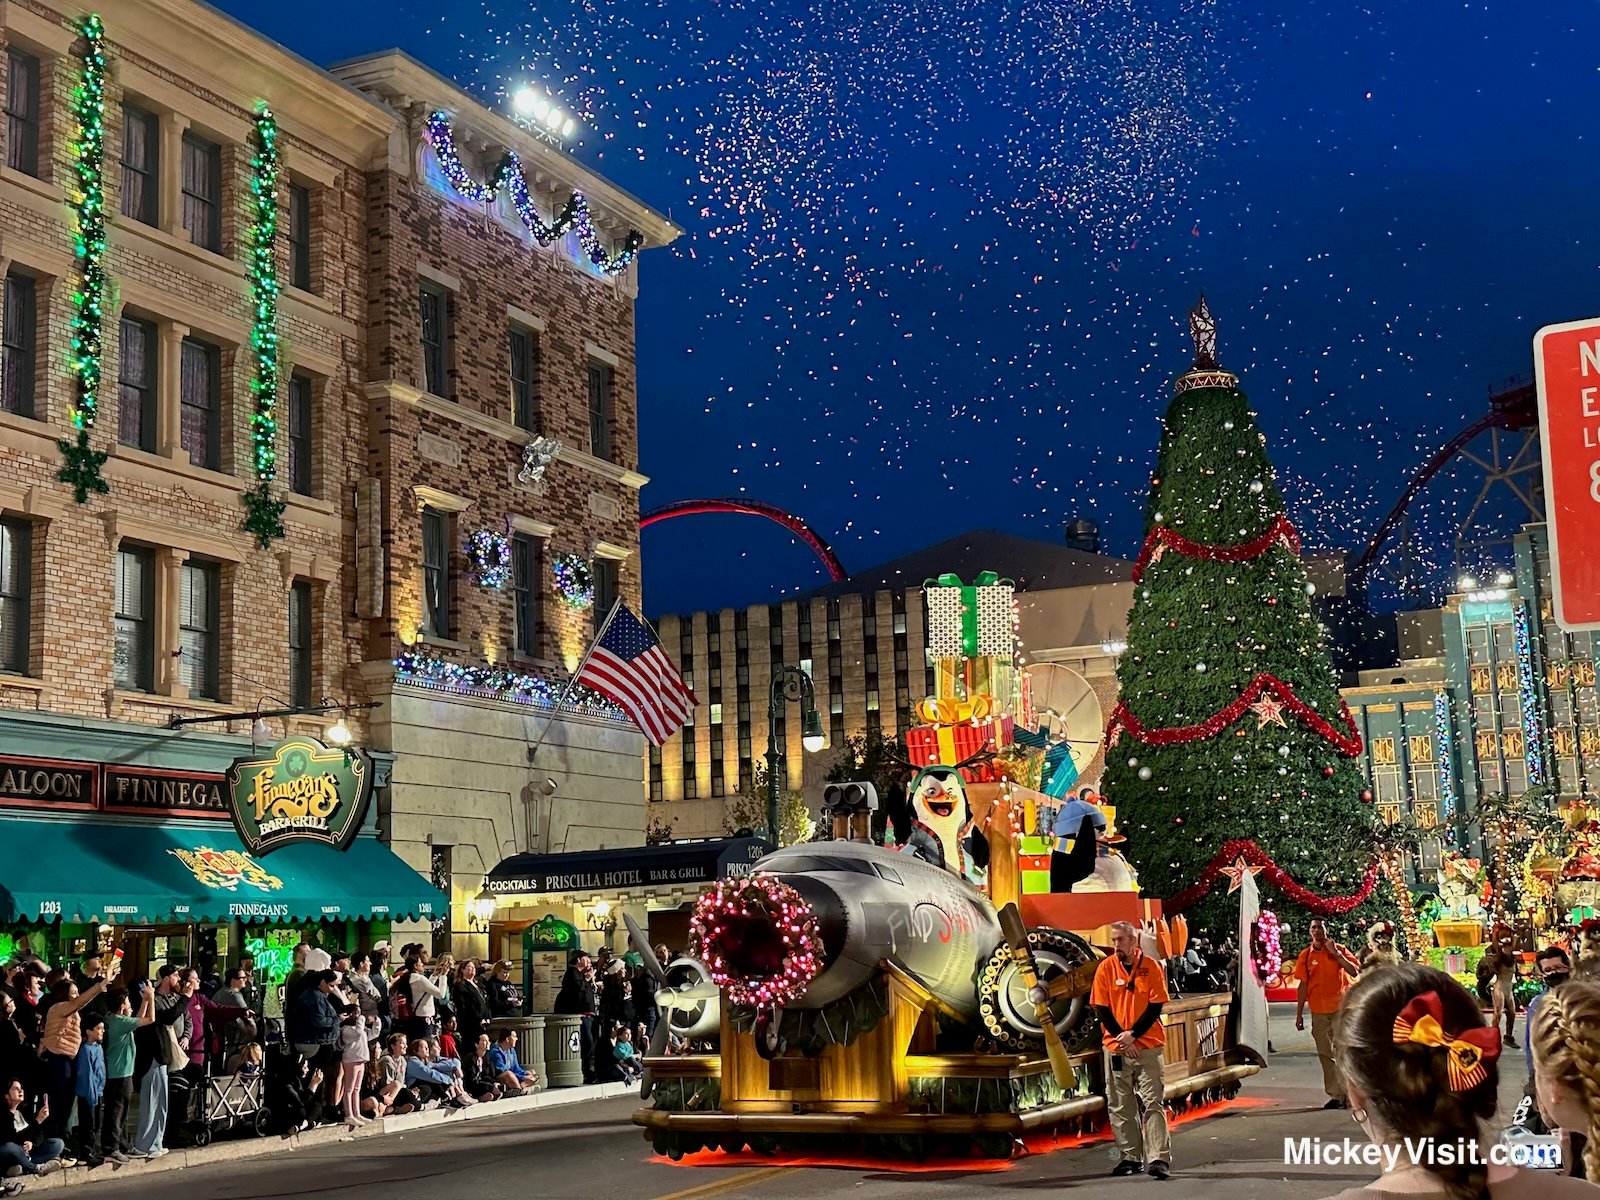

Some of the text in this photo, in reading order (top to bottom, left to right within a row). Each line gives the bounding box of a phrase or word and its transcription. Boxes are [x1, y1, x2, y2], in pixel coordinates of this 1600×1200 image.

[1583, 427, 1600, 448] L
[545, 869, 643, 890] PRISCILLA HOTEL
[650, 866, 706, 881] BAR & GRILL
[489, 879, 537, 892] COCKTAILS
[40, 901, 62, 915] 1203
[228, 903, 288, 916] FINNEGAN'S
[887, 909, 934, 954] FIND
